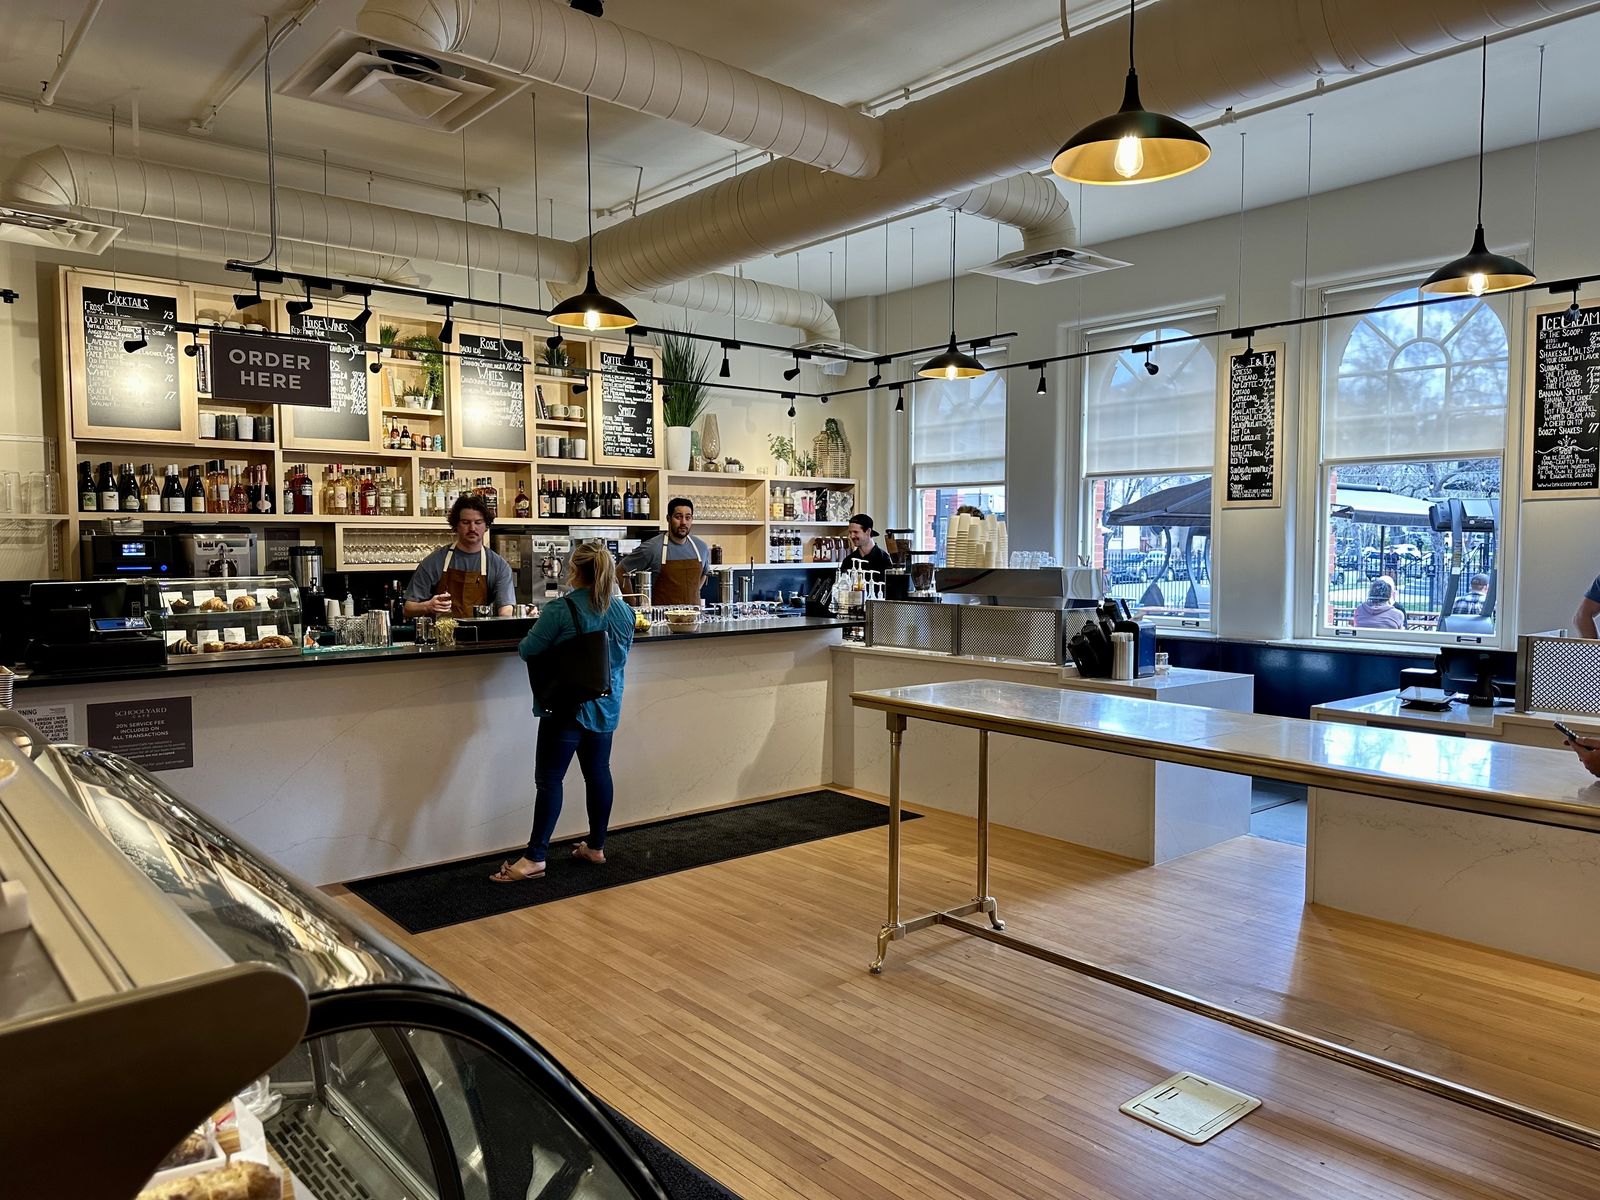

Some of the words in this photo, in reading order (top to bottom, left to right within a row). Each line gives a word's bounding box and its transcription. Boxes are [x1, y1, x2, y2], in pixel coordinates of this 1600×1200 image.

[107, 292, 149, 309] COCKTAILS
[303, 315, 323, 330] HOUSE
[323, 317, 348, 333] WINES
[1542, 316, 1561, 331] ICE
[1540, 331, 1547, 340] BY
[1549, 330, 1561, 339] THE
[1562, 328, 1583, 337] SCOOP:
[229, 349, 311, 371] ORDER
[240, 370, 302, 390] HERE
[477, 367, 505, 382] WHITES
[1538, 389, 1564, 399] BANANA
[1565, 387, 1583, 396] SPLIT:
[1584, 411, 1596, 419] AND
[1538, 426, 1557, 436] BOOZY
[1558, 426, 1583, 435] SHAKES:
[114, 707, 168, 718] SCHOOLYARD
[120, 726, 150, 734] INCLUDED
[129, 720, 154, 728] SERVICE
[125, 730, 169, 740] TRANSACTIONS
